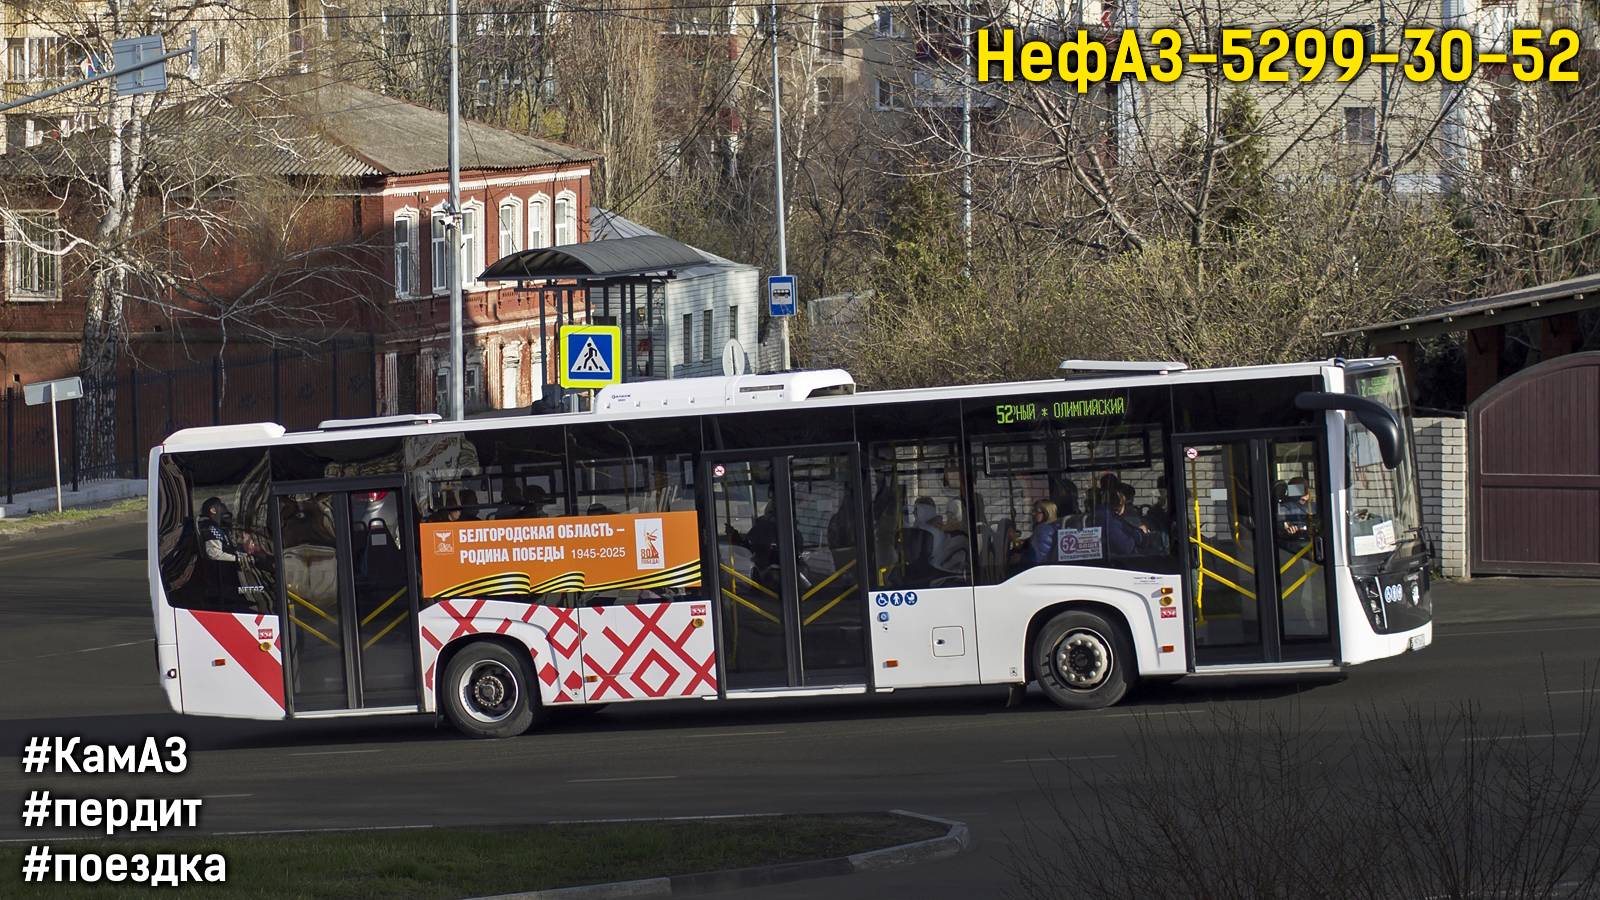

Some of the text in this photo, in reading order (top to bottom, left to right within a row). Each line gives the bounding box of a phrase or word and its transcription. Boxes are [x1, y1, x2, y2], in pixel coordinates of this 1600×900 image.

[996, 404, 1014, 424] 52
[1053, 396, 1124, 418] ОЛИМПИЙСКИЙ
[459, 525, 555, 543] БЕЛГОРОДСКАЯ
[558, 522, 614, 539] ОБЛАСТЬ
[1062, 537, 1076, 552] 52
[460, 546, 626, 565] РОДИНА ПОБЕДЫ 1945-2025
